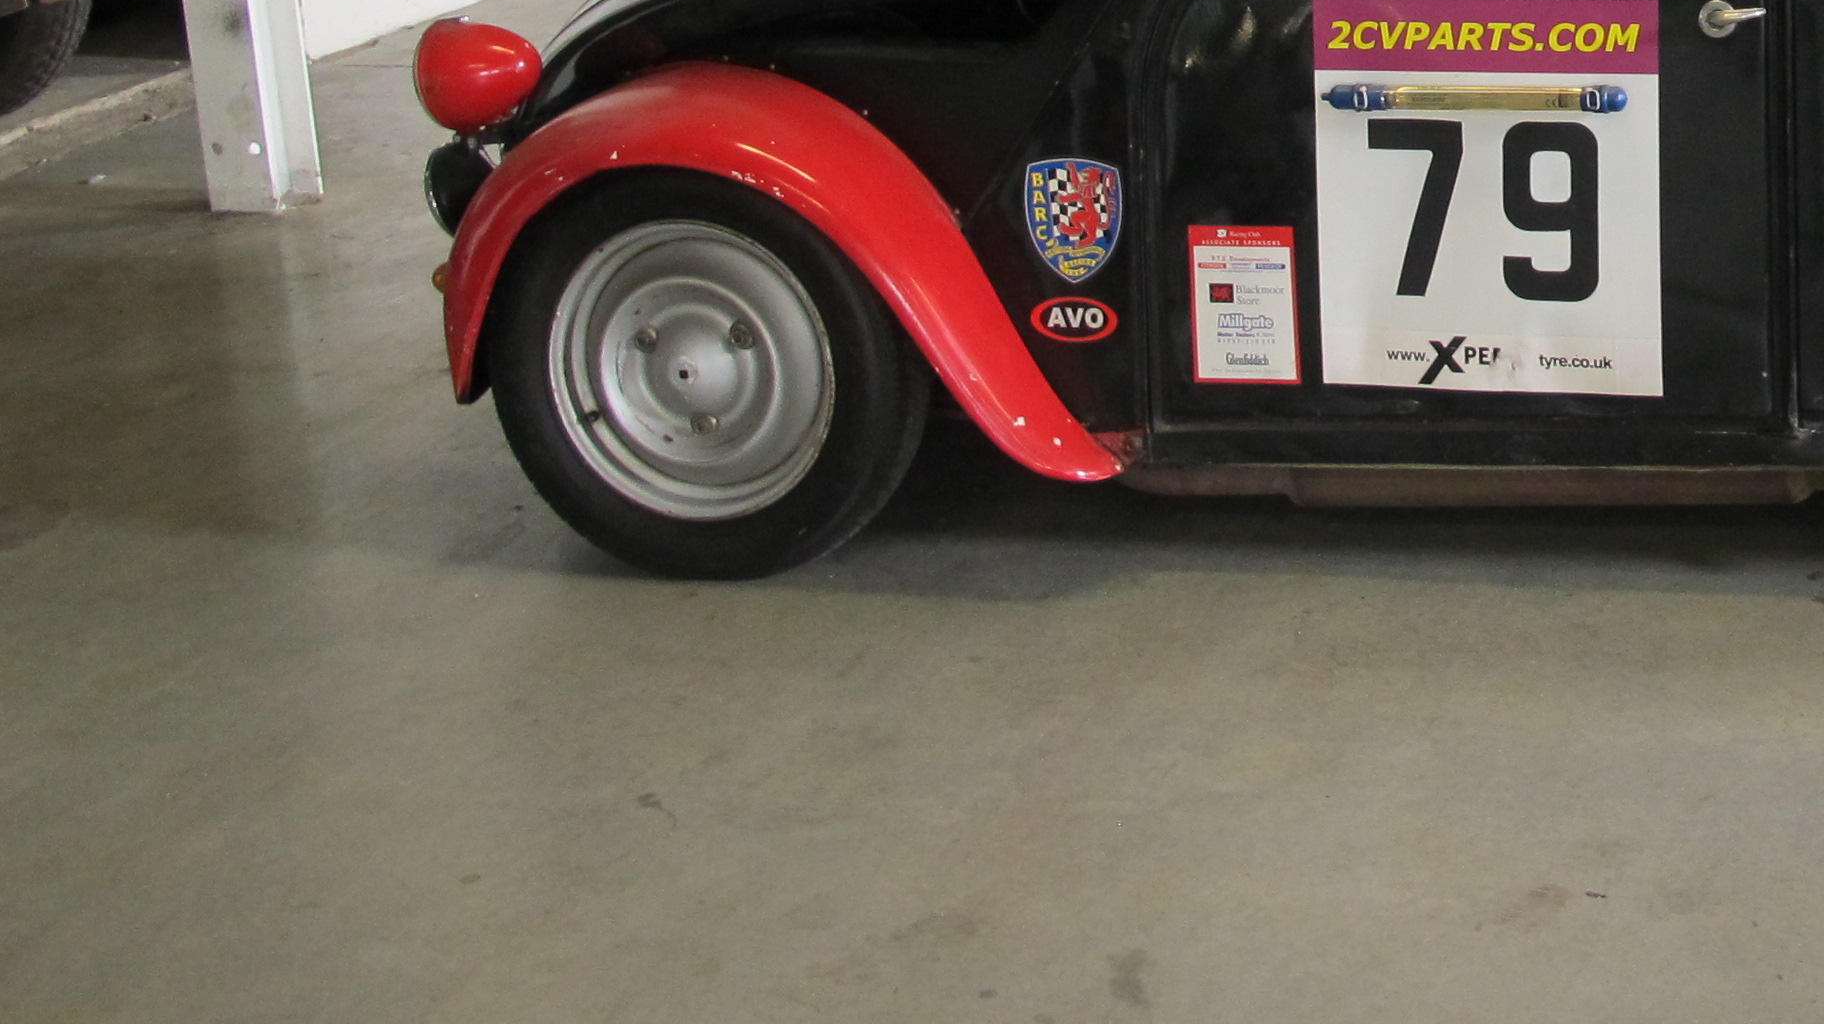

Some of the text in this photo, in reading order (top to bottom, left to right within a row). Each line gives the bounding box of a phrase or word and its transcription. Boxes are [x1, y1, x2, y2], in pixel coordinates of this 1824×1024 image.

[1327, 20, 1641, 53] 2CVPARTS.COM
[1031, 172, 1049, 241] BARC
[1367, 118, 1599, 302] 79
[1235, 284, 1284, 295] Blackmoor
[1236, 296, 1260, 306] Store
[1047, 306, 1105, 329] AVO
[1217, 313, 1274, 331] Millgate
[1539, 354, 1613, 370] tyre.co.uk
